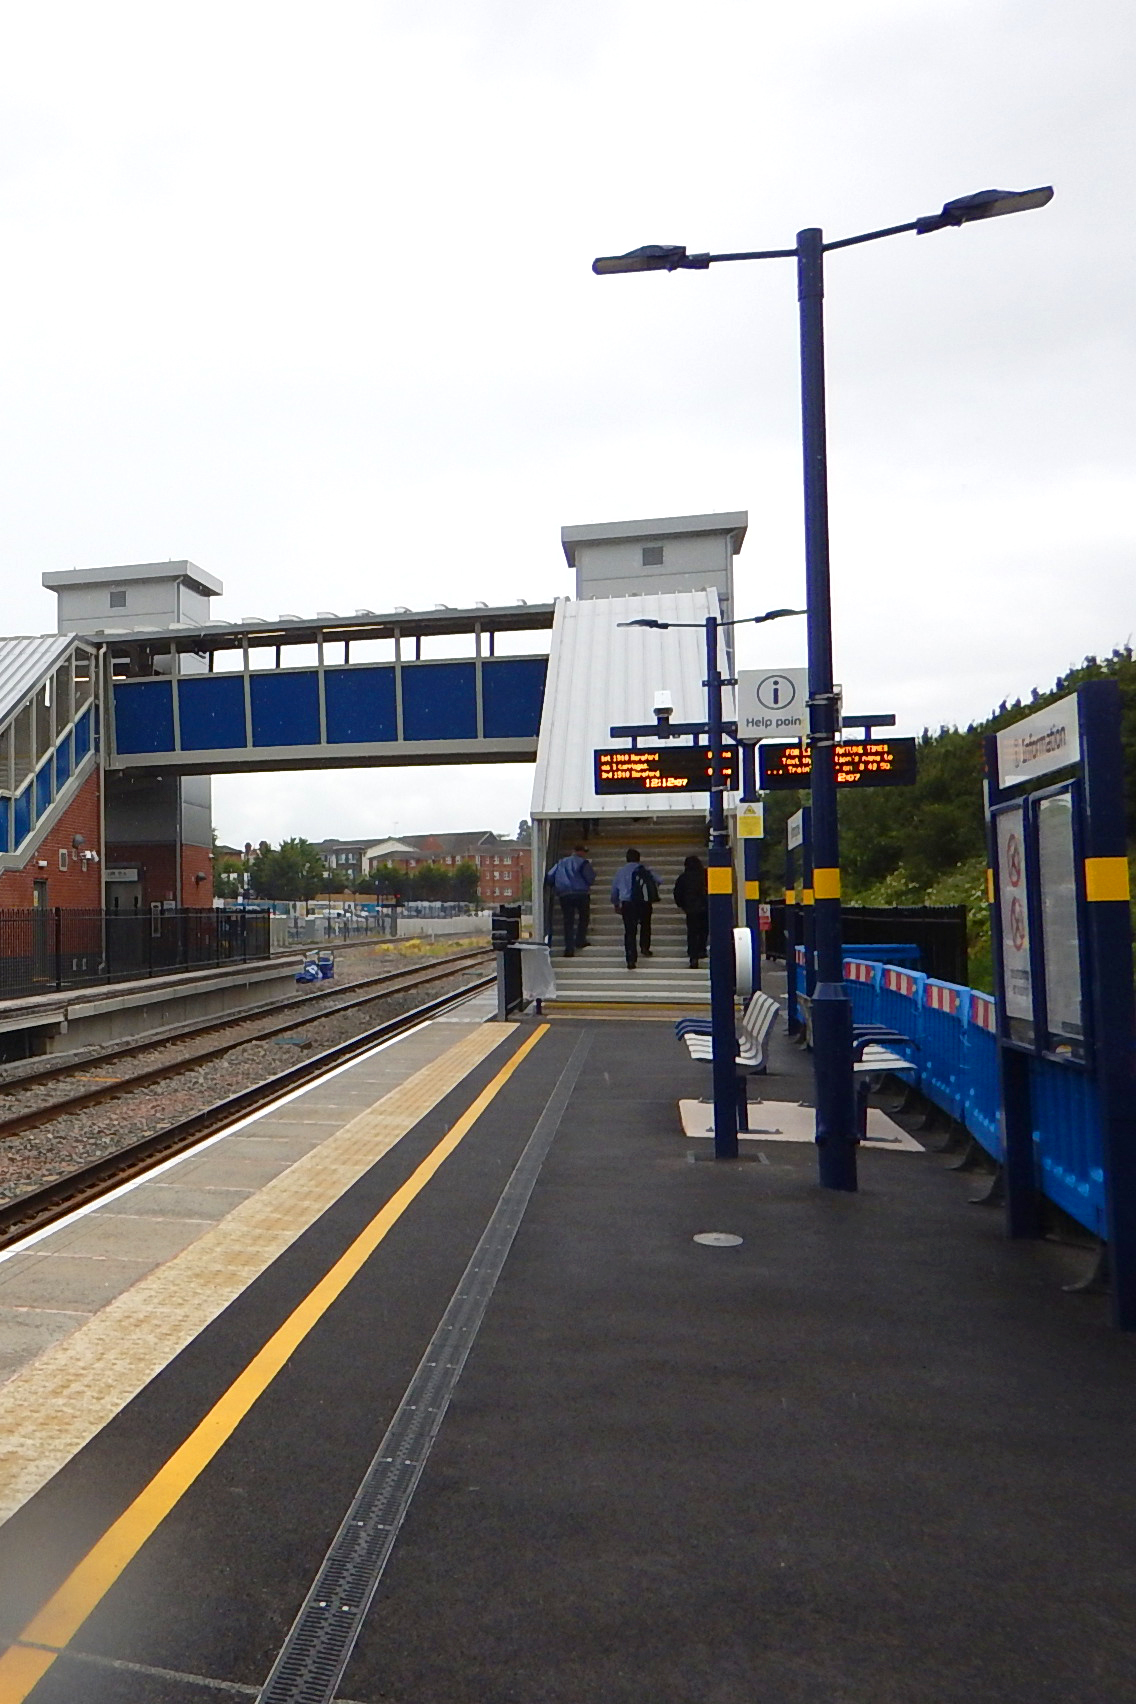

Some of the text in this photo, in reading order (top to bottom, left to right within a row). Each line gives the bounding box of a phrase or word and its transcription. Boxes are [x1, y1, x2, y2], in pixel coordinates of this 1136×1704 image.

[745, 716, 802, 729] Help poin
[1021, 724, 1066, 764] Information
[786, 748, 800, 756] FOR
[866, 744, 889, 753] TIMES
[630, 752, 659, 762] Hereford
[884, 753, 894, 761] to
[631, 770, 660, 778] Hereford
[645, 777, 688, 788] 12:12:07
